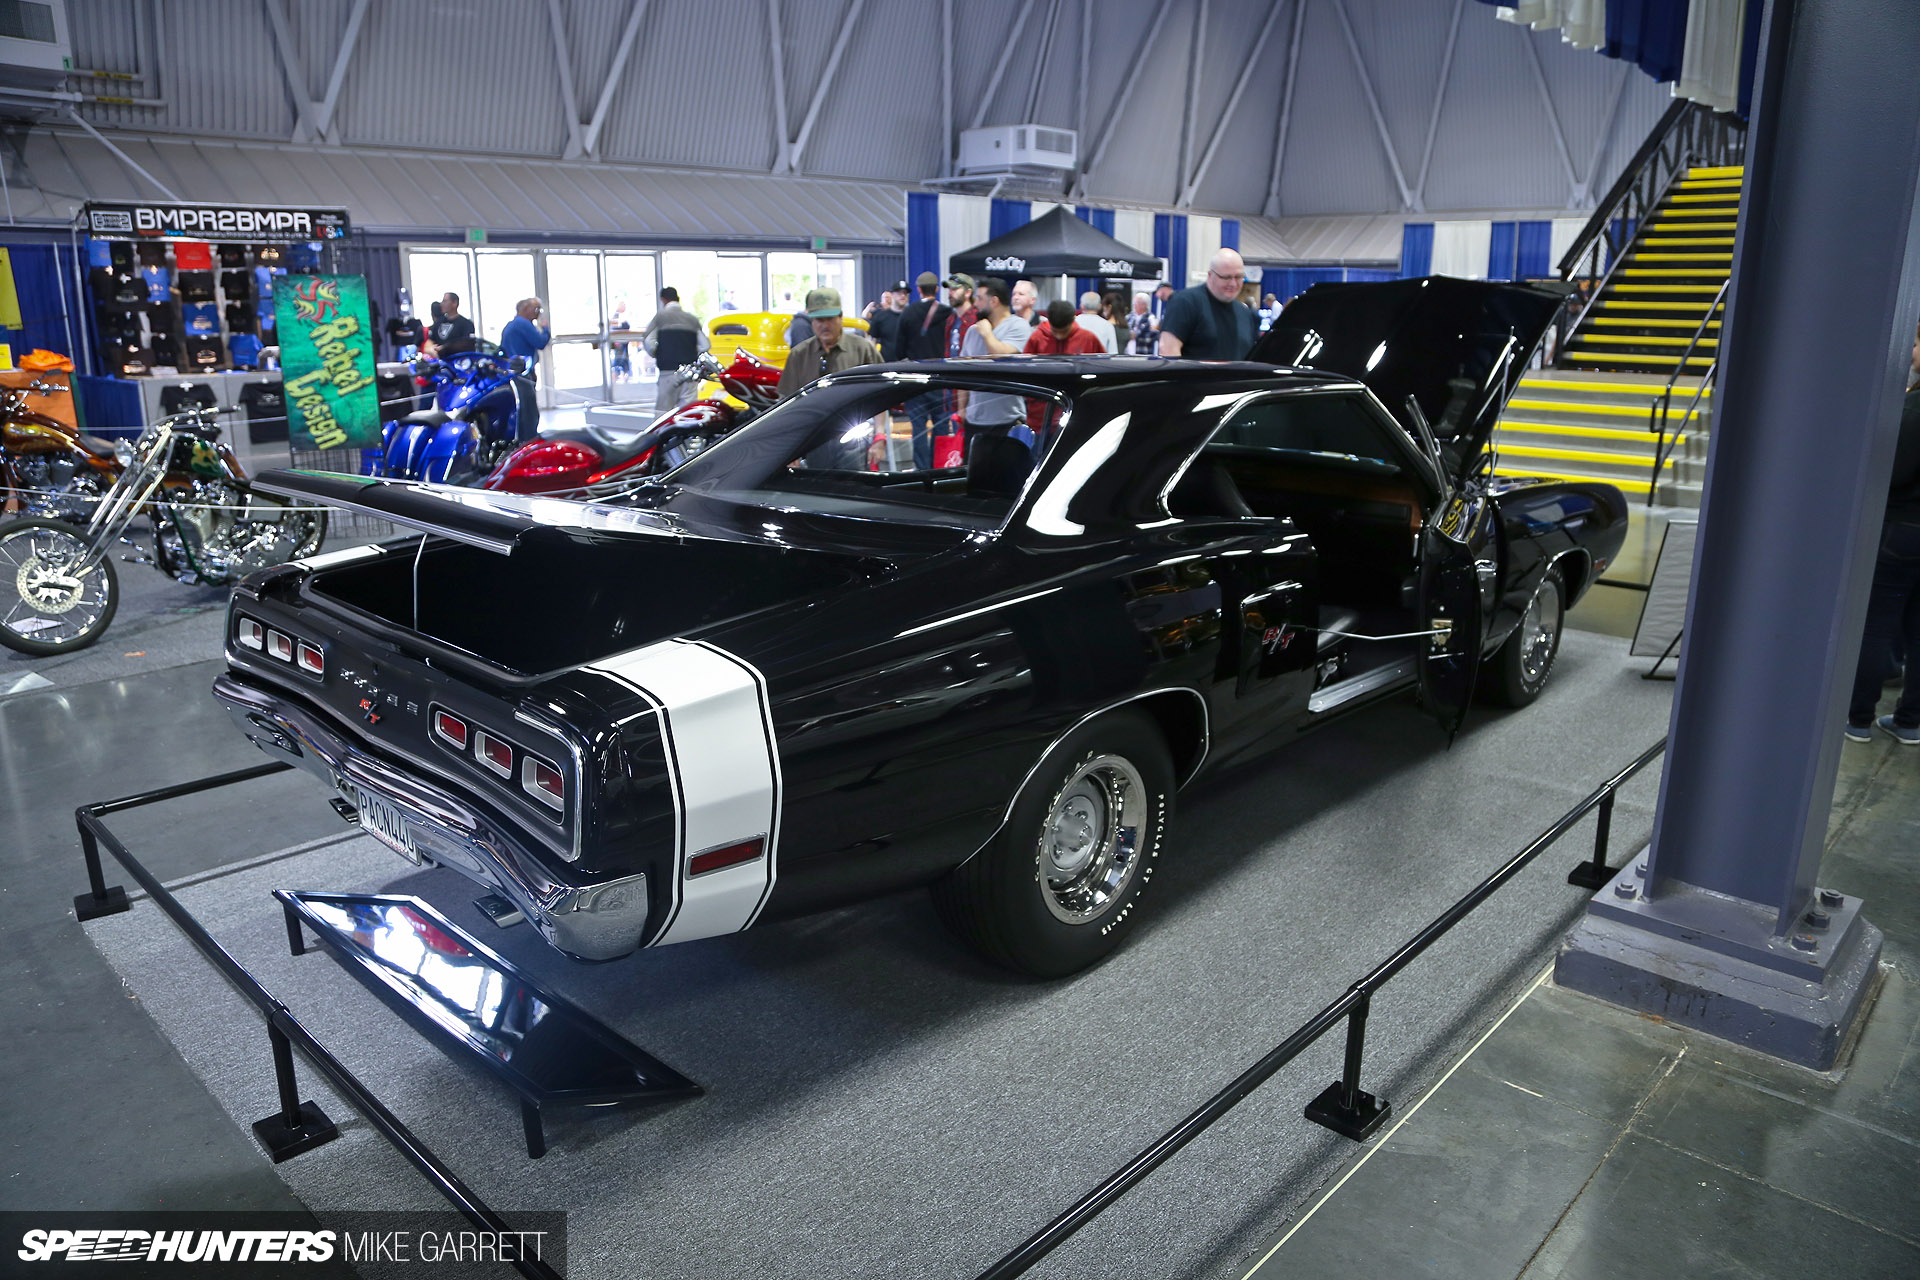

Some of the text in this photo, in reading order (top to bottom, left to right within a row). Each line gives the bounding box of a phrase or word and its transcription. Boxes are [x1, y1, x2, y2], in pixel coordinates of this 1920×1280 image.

[135, 208, 311, 233] BMPR2BMPR
[985, 256, 1026, 273] SolarCity
[1099, 258, 1134, 276] SolarCity
[309, 316, 376, 396] Rebel
[1262, 623, 1296, 655] R/T
[359, 698, 381, 724] R/T
[1151, 794, 1165, 858] POLYGLAS
[1142, 867, 1153, 883] GT
